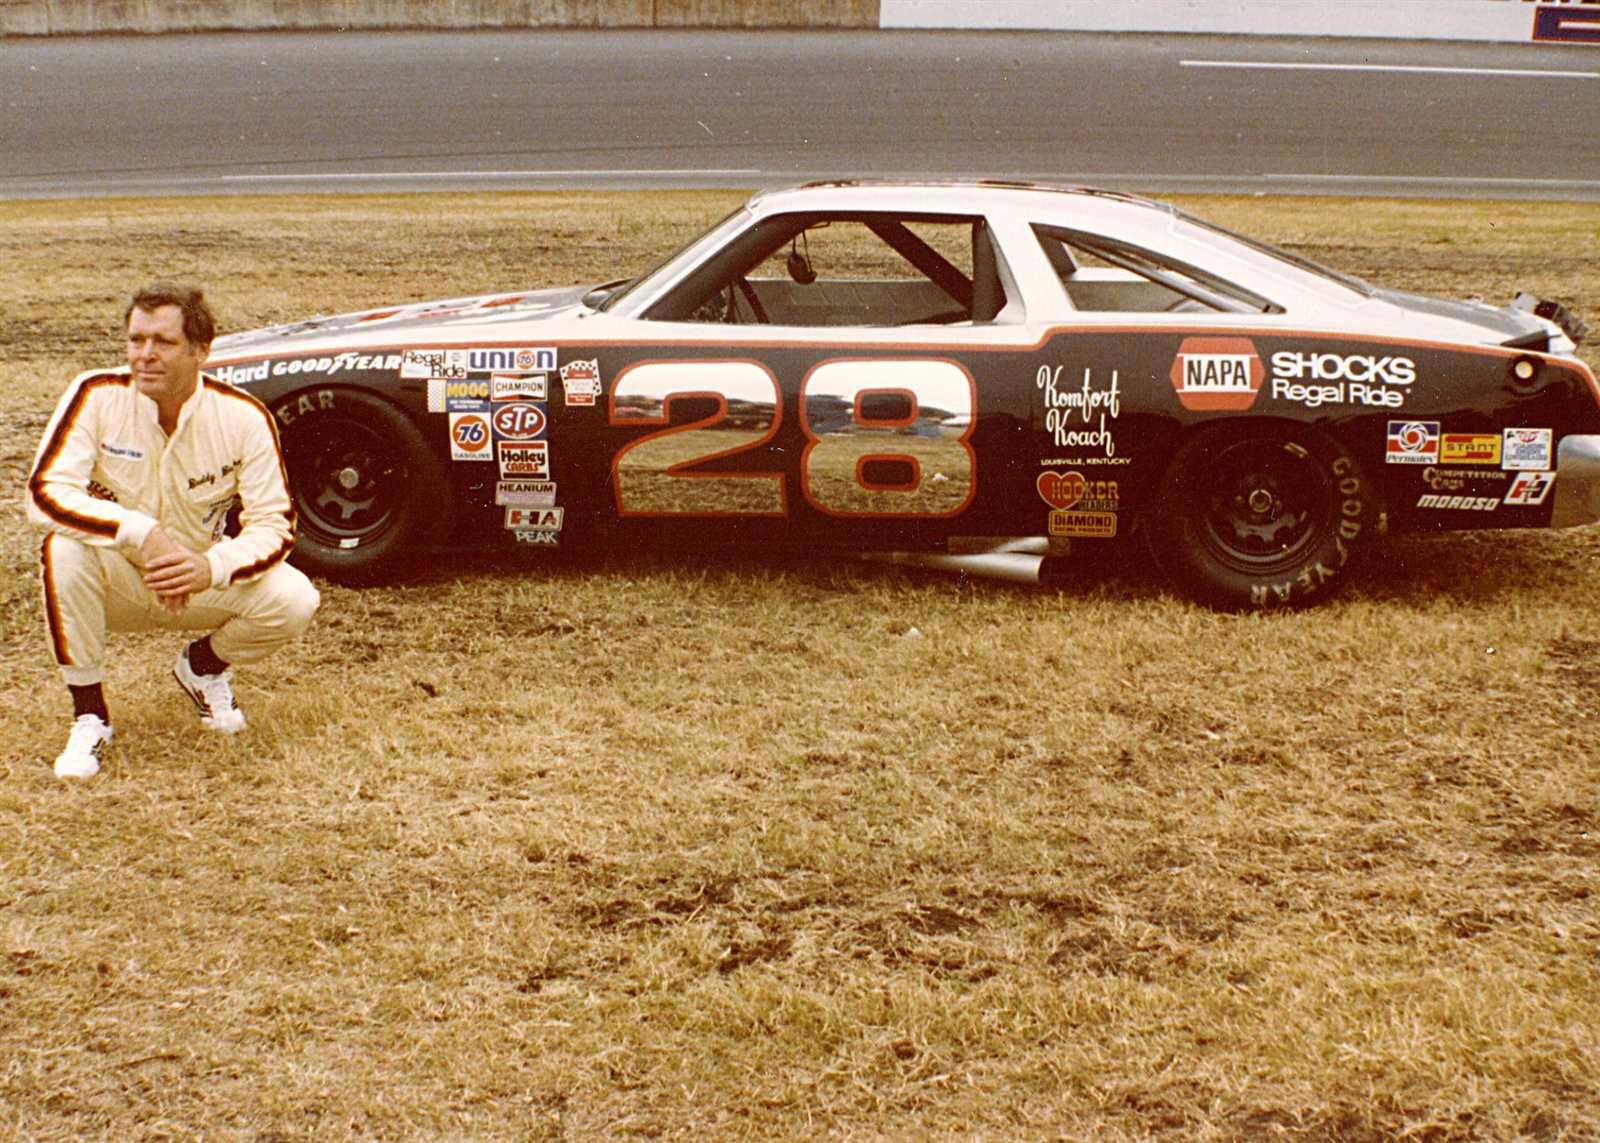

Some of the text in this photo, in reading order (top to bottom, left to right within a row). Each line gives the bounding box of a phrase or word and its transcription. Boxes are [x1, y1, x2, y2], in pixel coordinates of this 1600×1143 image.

[404, 350, 447, 367] Regal
[214, 352, 401, 384] Hard GOODYEAR
[431, 363, 465, 377] Ride
[1187, 352, 1416, 386] NAPA SHOCKS
[447, 382, 489, 398] MOOG
[495, 382, 544, 393] CHAMPION
[1036, 364, 1121, 423] Komfort
[1272, 379, 1404, 407] Regal Ride
[500, 407, 538, 431] STP
[458, 423, 484, 443] 76
[608, 356, 977, 518] 28
[1046, 408, 1115, 457] Koach
[1445, 443, 1497, 452] STANT
[501, 450, 546, 466] Holley
[499, 484, 554, 493] HEANIUM
[1051, 481, 1120, 500] HOOKER
[1416, 494, 1500, 511] MOROSO
[515, 530, 558, 544] PEAK
